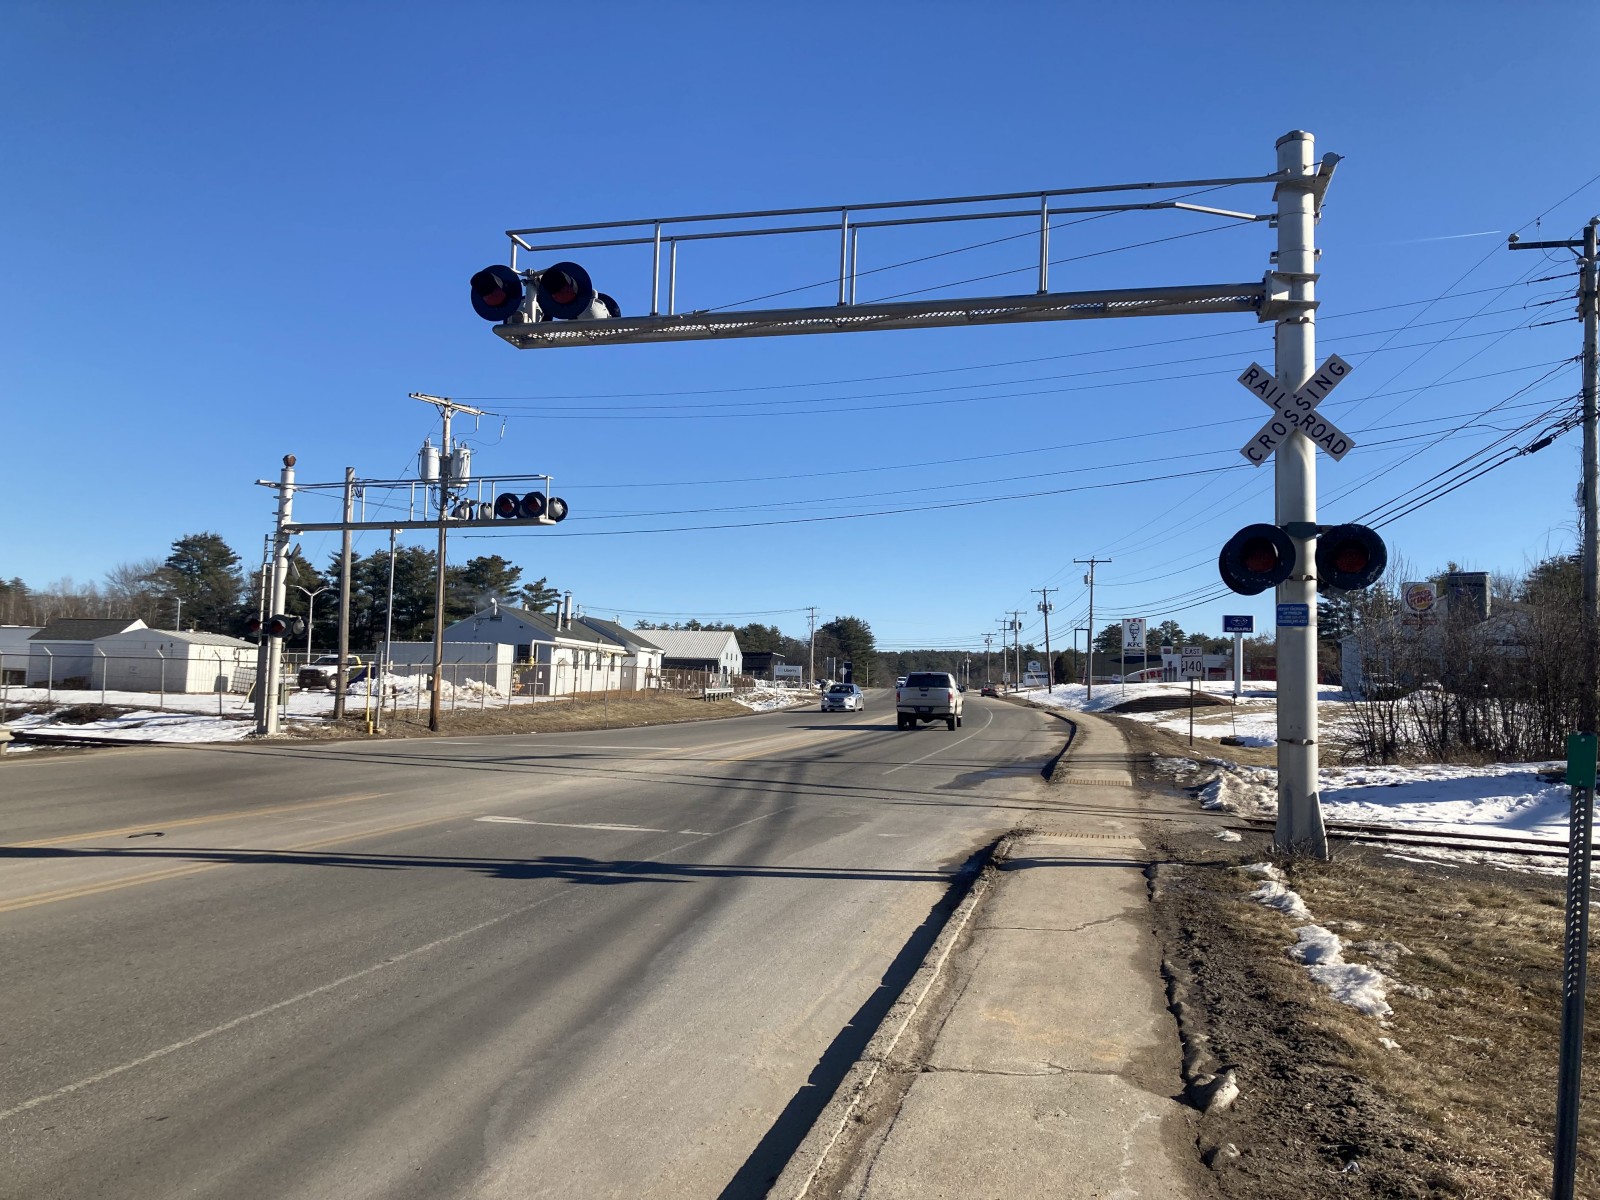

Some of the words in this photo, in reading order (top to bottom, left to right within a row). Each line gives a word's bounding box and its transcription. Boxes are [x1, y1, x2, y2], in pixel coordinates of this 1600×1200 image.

[1247, 362, 1345, 461] CROSSING
[1184, 647, 1200, 655] EAST
[1185, 660, 1201, 672] 140
